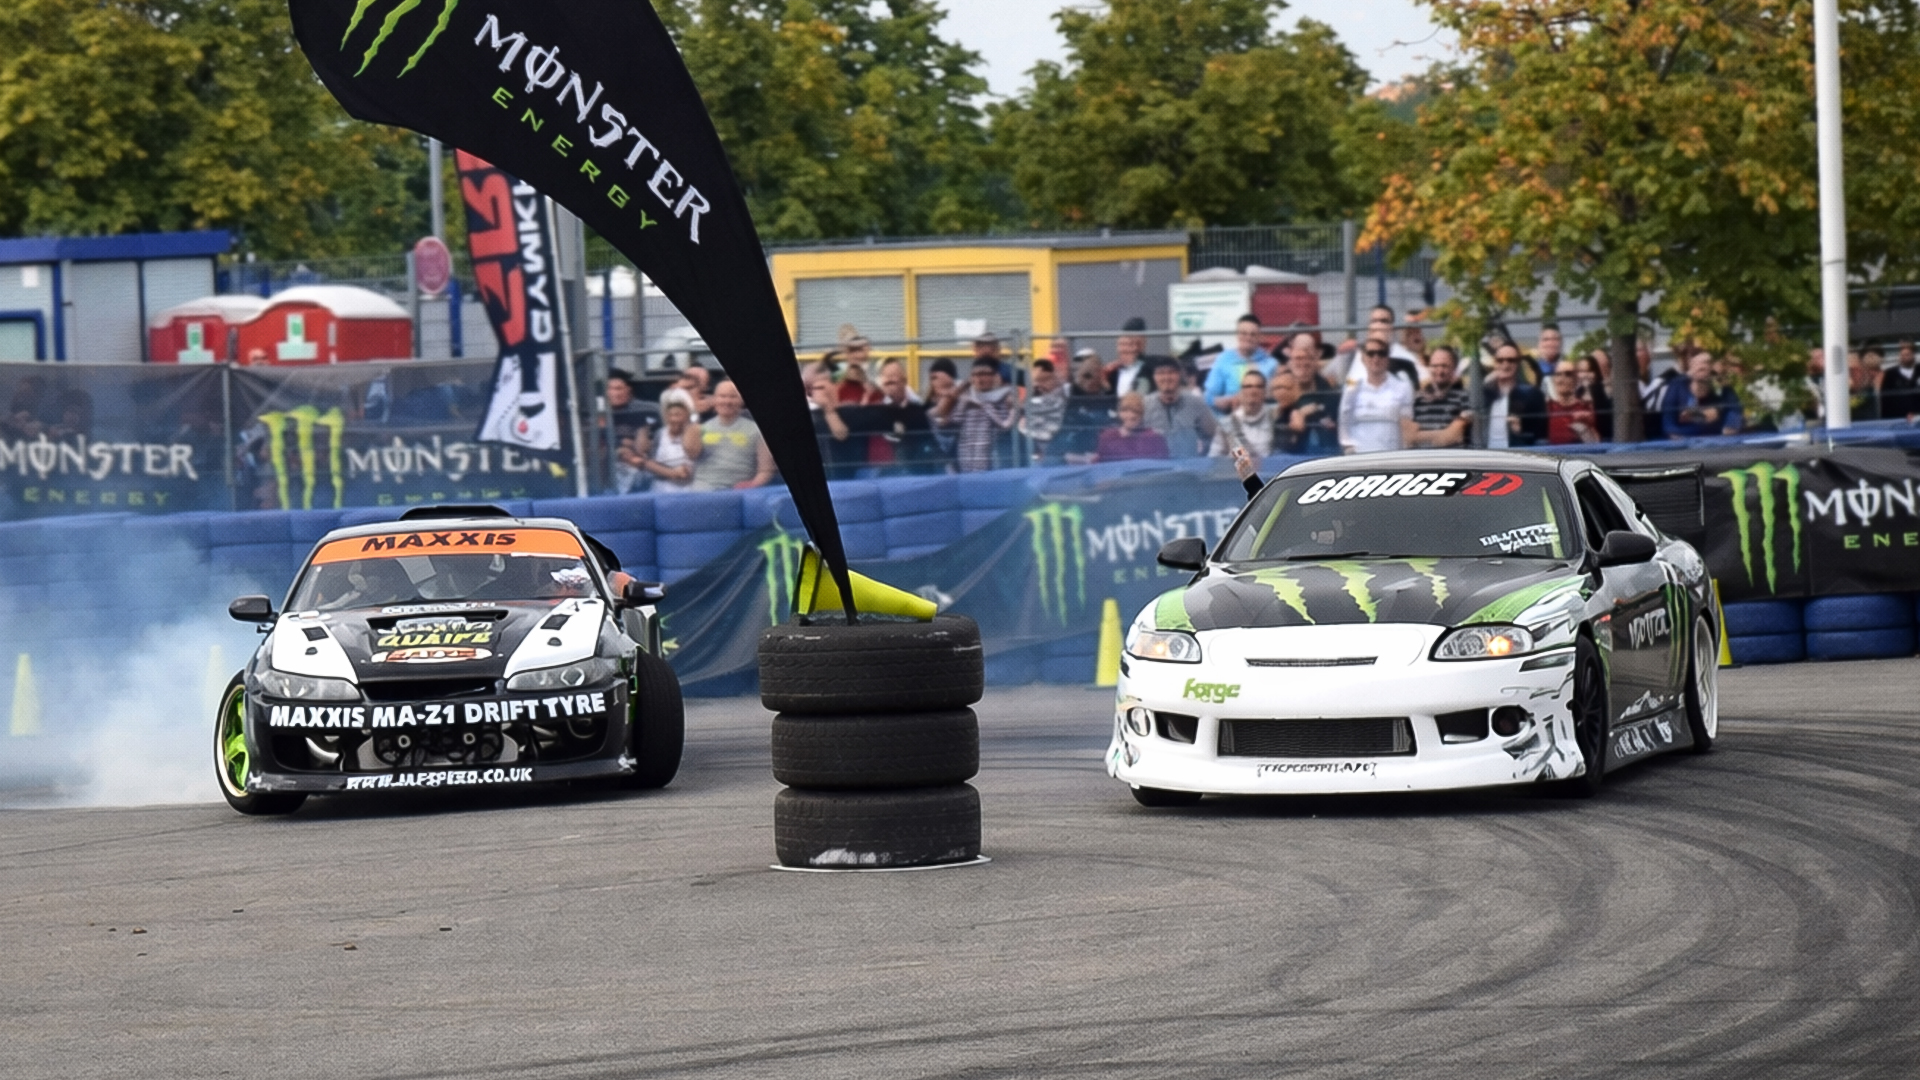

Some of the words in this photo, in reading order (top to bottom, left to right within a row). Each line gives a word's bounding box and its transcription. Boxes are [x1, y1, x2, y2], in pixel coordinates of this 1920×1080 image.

[474, 14, 711, 244] MONSTER
[491, 86, 658, 230] ENERGY
[346, 434, 542, 482] MONSTE
[361, 532, 517, 552] MAXXIS
[269, 705, 366, 728] MAXXIS
[372, 704, 456, 728] MA-Z1
[464, 700, 540, 724] DRIFT
[542, 693, 606, 718] TYRE
